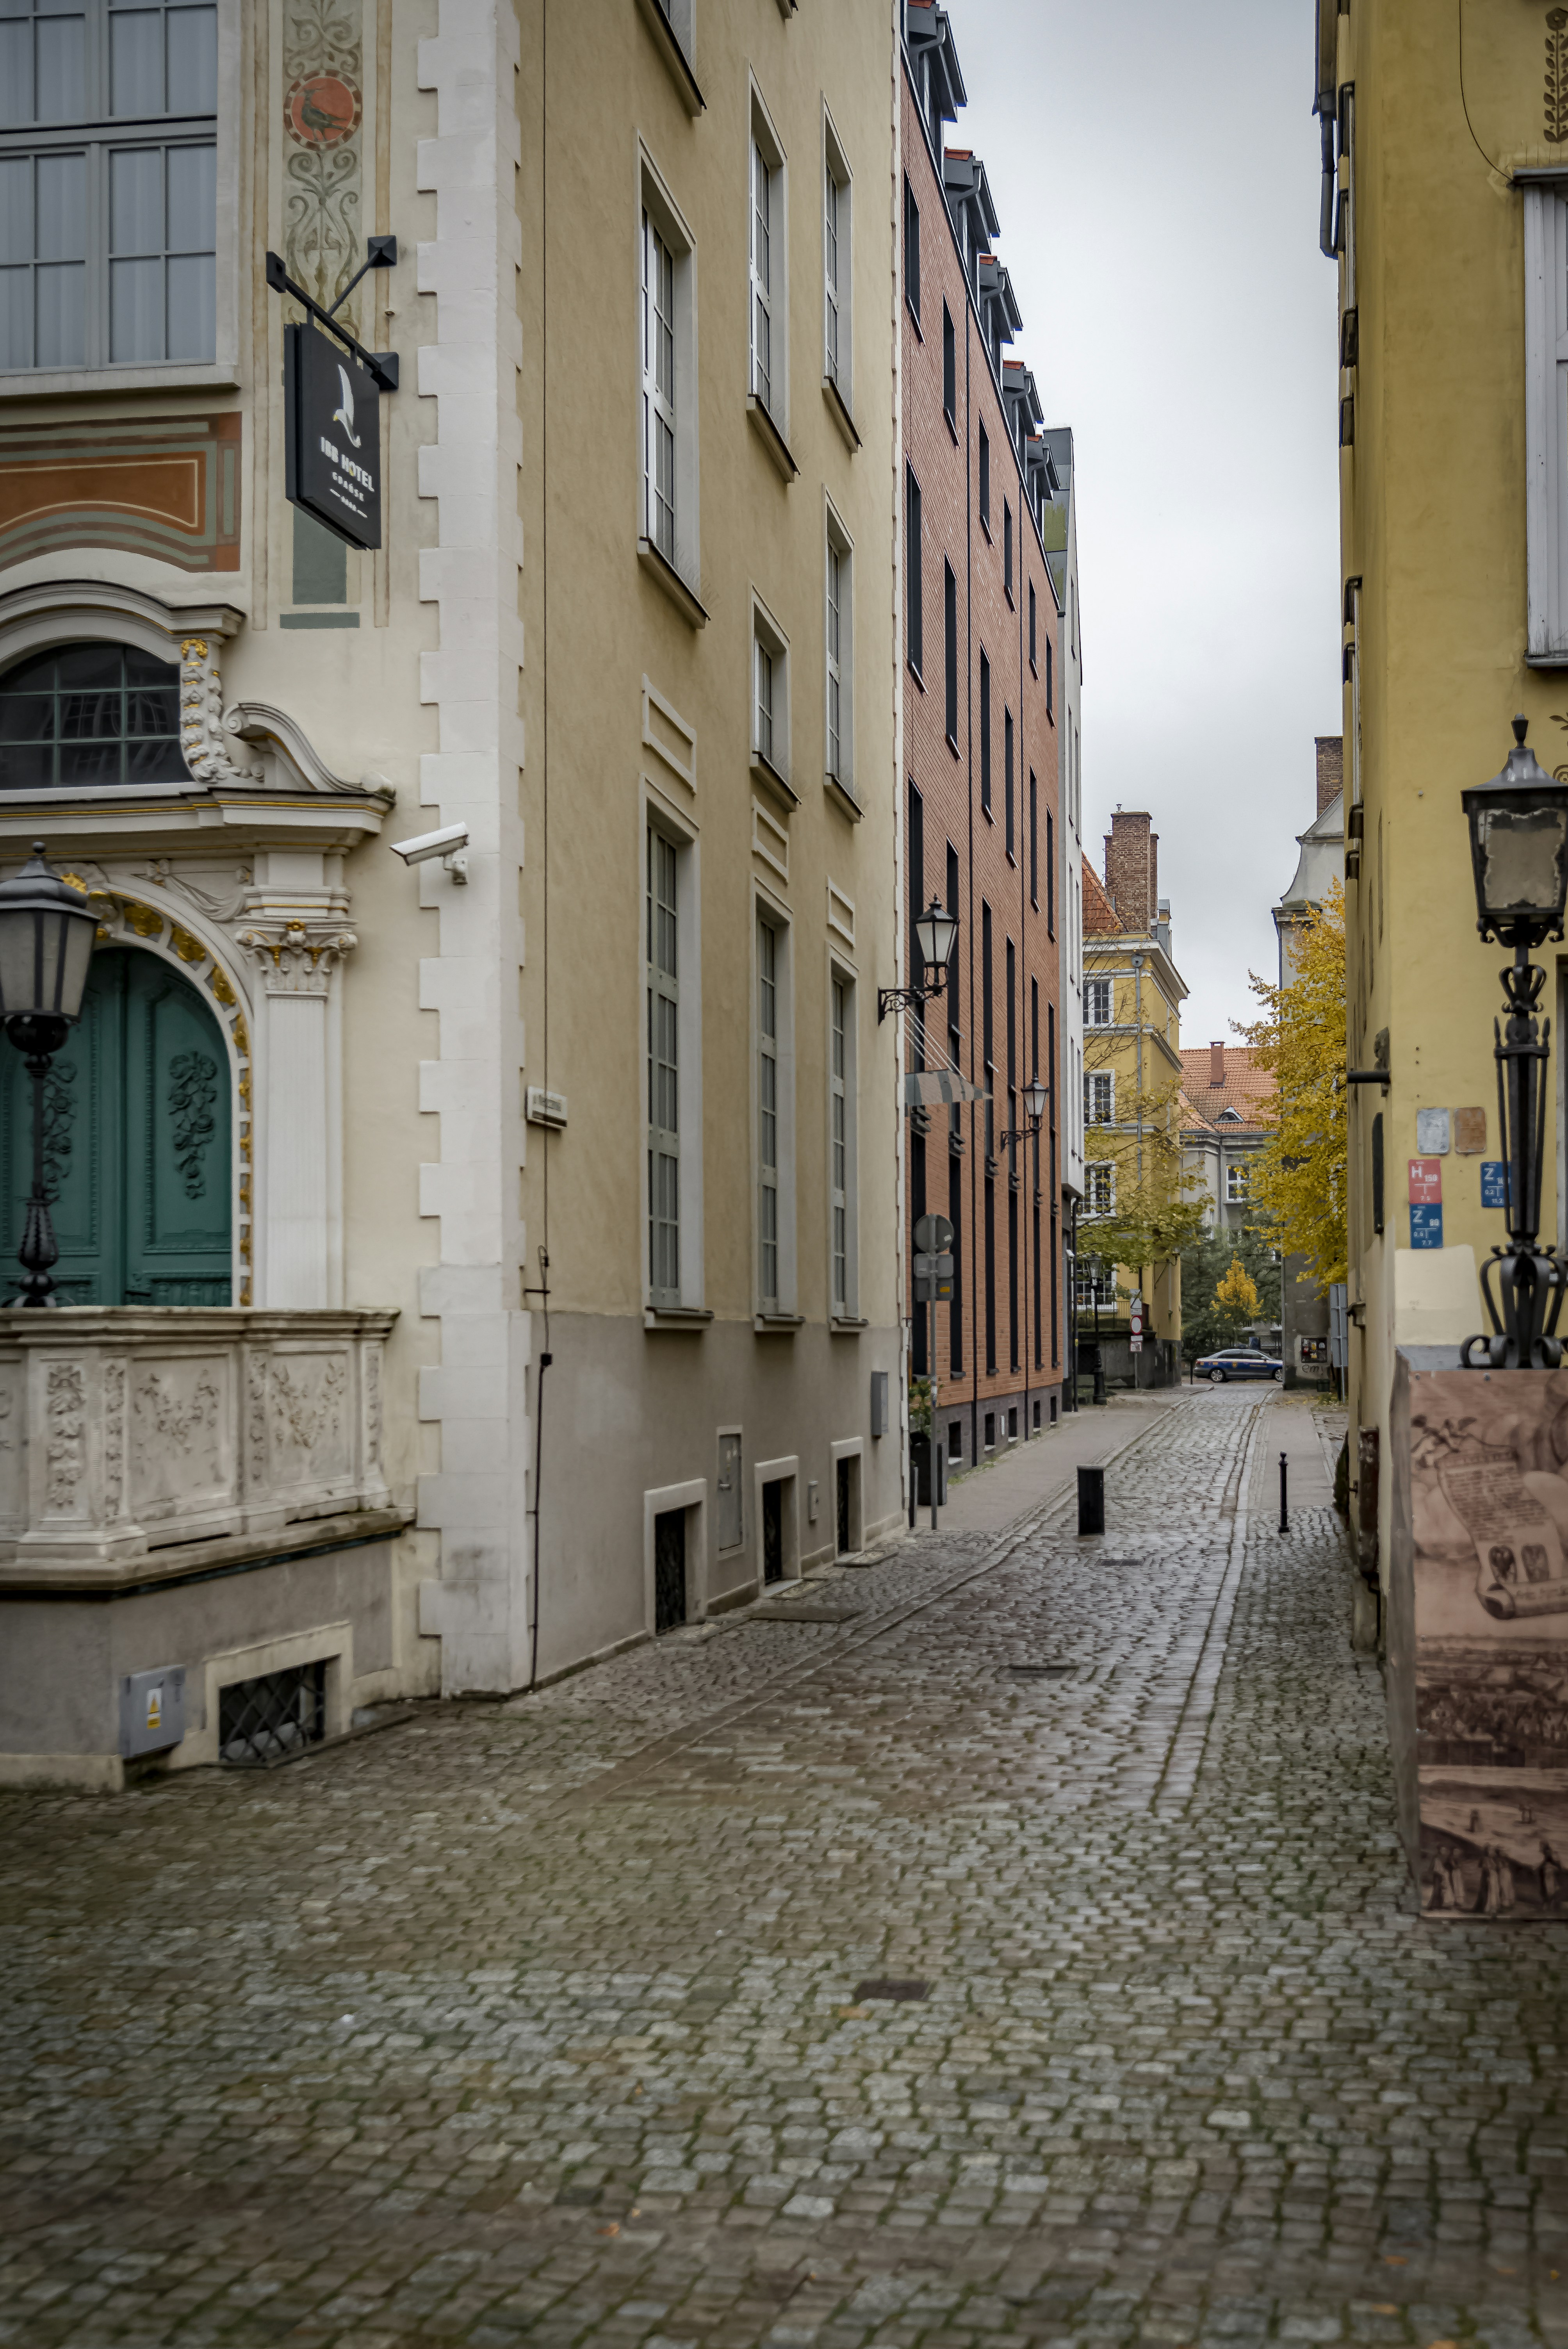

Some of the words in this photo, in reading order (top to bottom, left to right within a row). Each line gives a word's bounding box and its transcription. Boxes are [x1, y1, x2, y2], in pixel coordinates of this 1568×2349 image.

[320, 437, 339, 463] IBB
[341, 454, 375, 492] HOTEL
[1411, 1166, 1422, 1178] H
[1484, 1167, 1494, 1181] Z
[1413, 1210, 1423, 1223] Z
